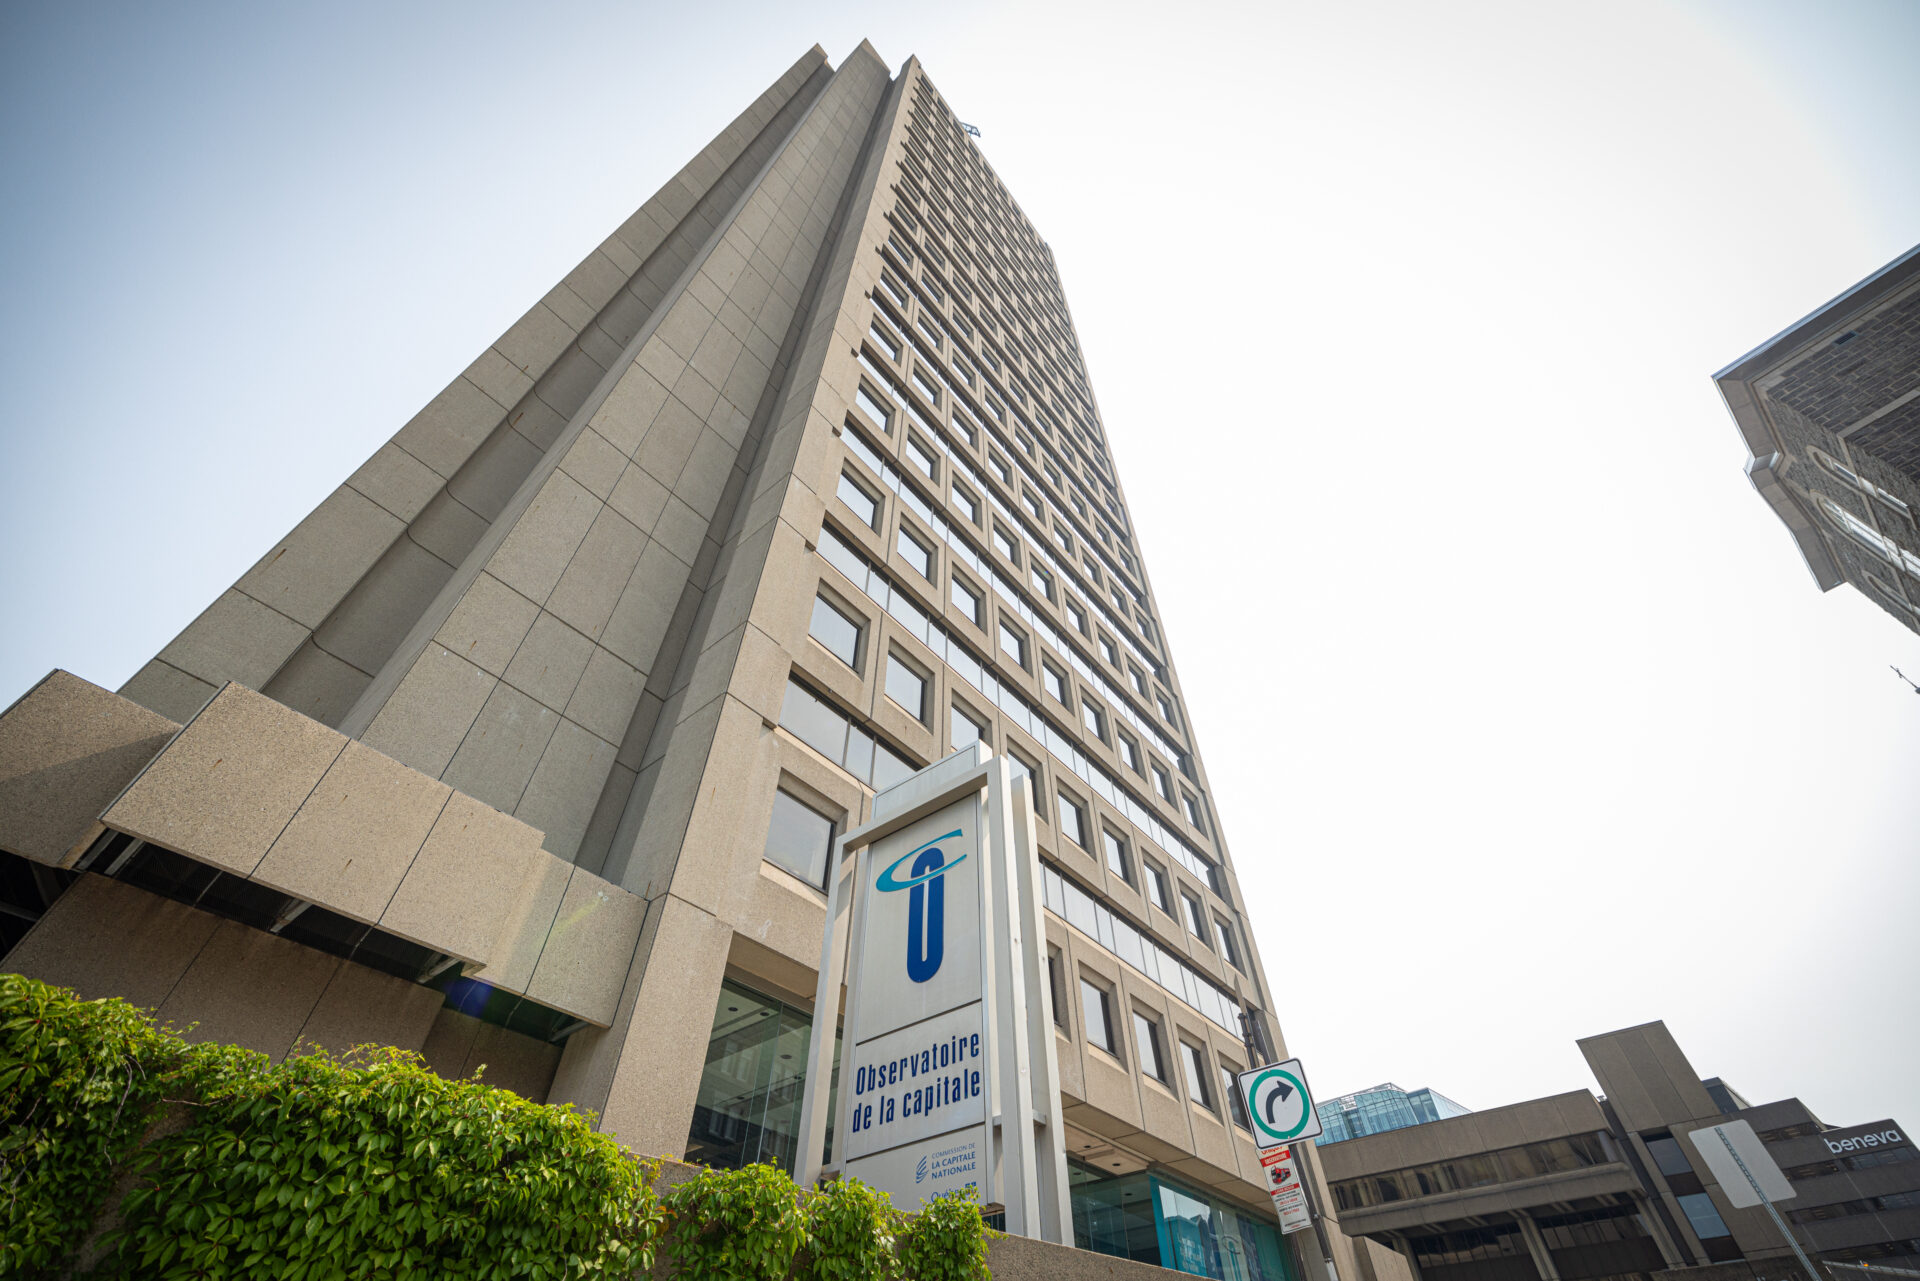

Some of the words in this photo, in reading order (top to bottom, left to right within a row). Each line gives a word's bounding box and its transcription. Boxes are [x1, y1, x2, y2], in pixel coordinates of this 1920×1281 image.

[856, 1033, 979, 1095] Observatoire
[852, 1102, 872, 1133] de
[879, 1095, 895, 1125] la
[903, 1068, 980, 1117] capitale
[931, 1145, 968, 1159] COMMISSION
[968, 1142, 976, 1150] DE
[1823, 1129, 1902, 1154] beneva
[931, 1161, 940, 1170] LA
[942, 1151, 976, 1167] CAPITALE
[931, 1161, 976, 1179] NATIONALE
